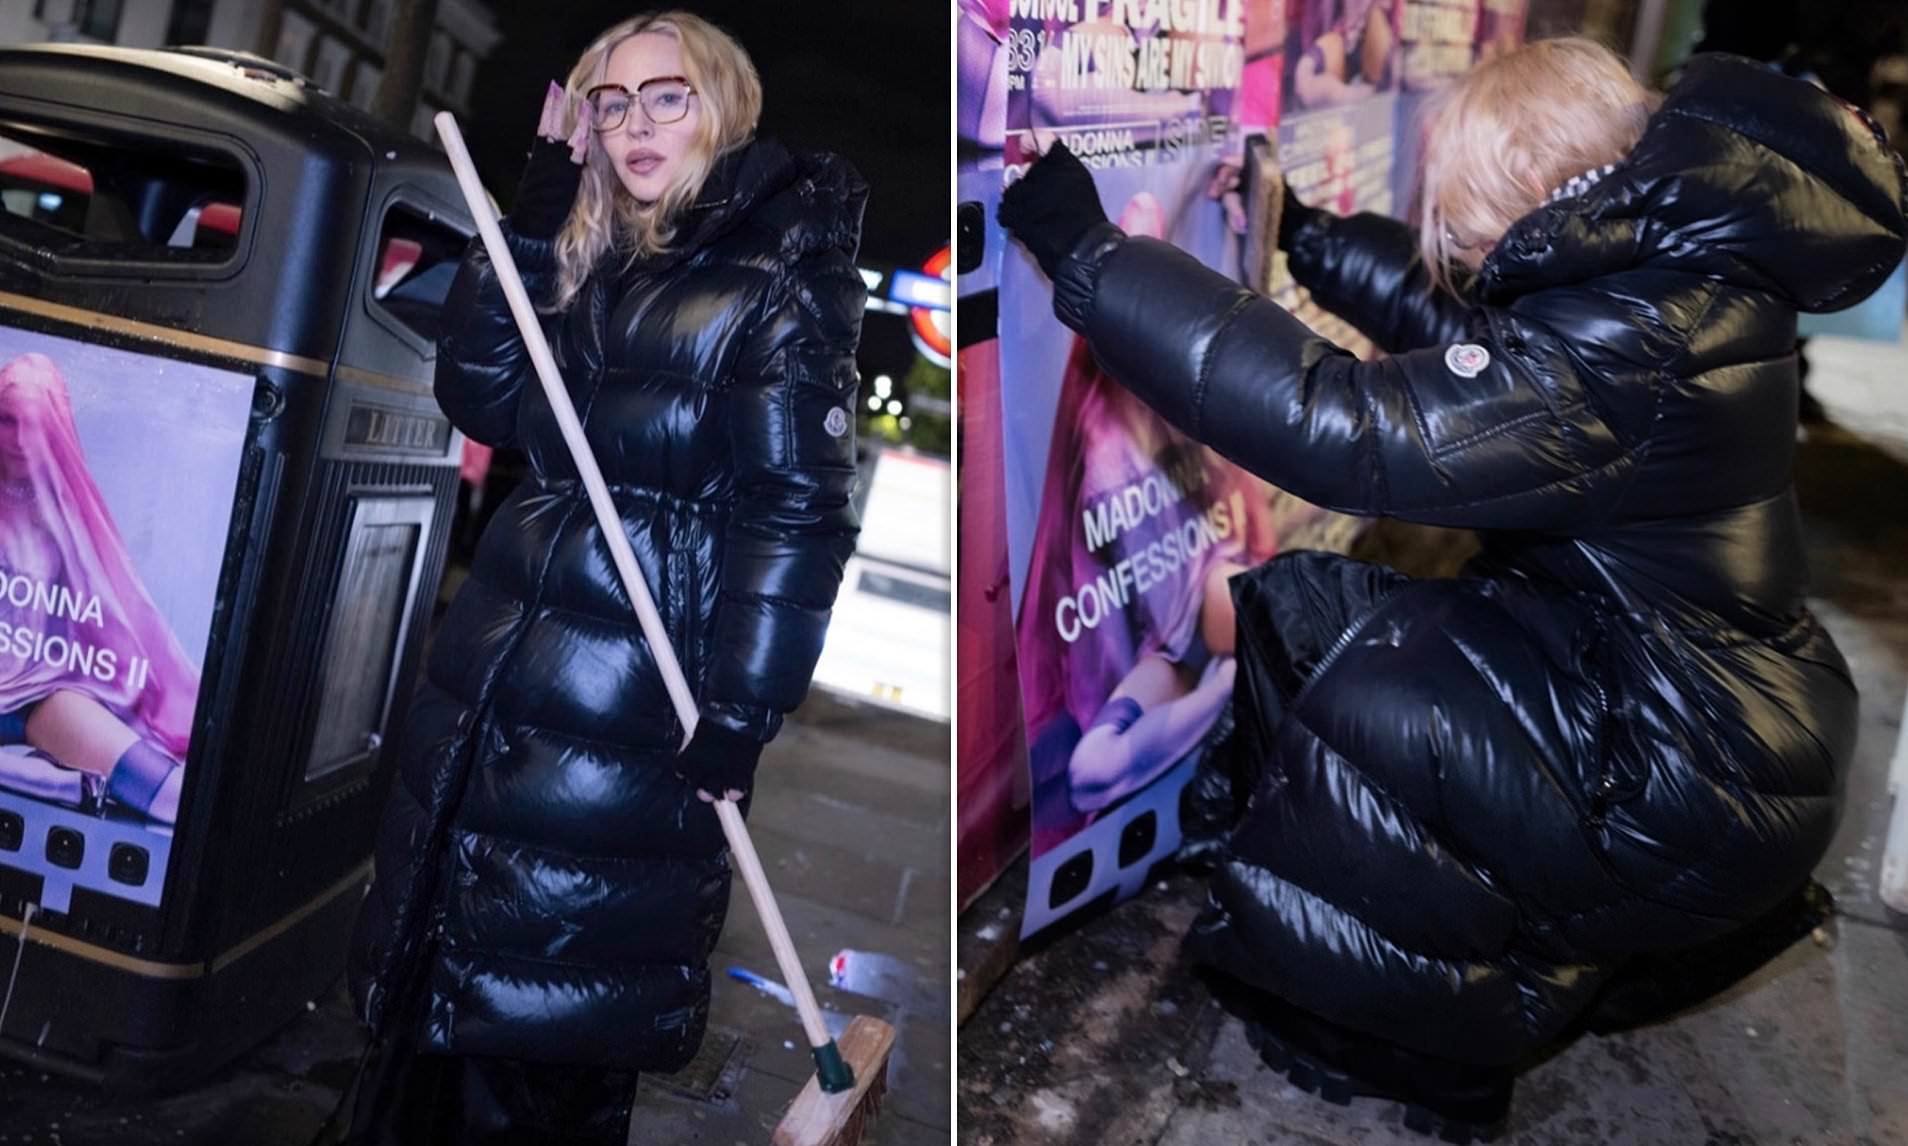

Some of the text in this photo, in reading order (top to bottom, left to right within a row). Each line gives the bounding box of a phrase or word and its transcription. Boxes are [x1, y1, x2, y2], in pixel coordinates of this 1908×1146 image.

[365, 411, 437, 447] LITTER
[1083, 464, 1209, 552] MADON
[1056, 501, 1232, 642] CONFESSIONS
